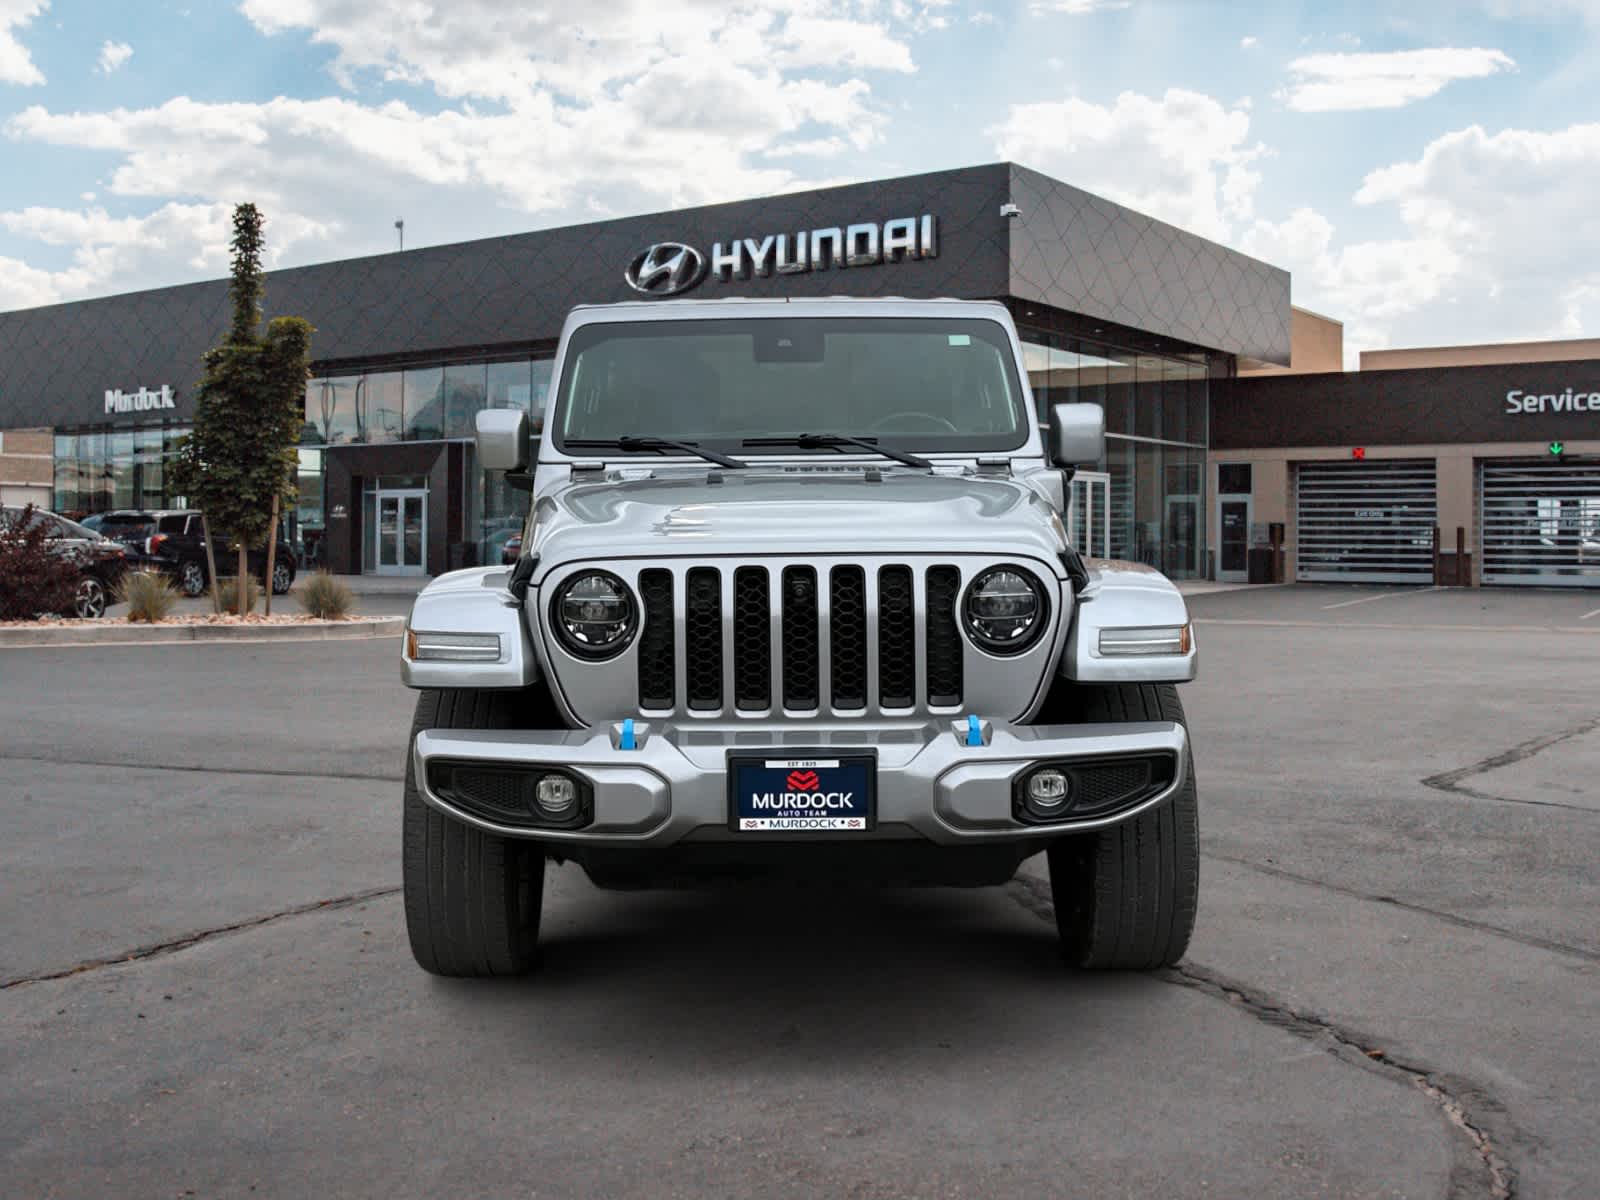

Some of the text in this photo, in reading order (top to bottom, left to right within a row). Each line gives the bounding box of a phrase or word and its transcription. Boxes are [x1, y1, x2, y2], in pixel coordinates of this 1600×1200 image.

[712, 214, 935, 281] HYUNDAI
[104, 384, 176, 414] Murdock
[1505, 387, 1600, 414] Service
[752, 792, 853, 809] MURDOCK
[769, 819, 837, 829] MURDOCK
